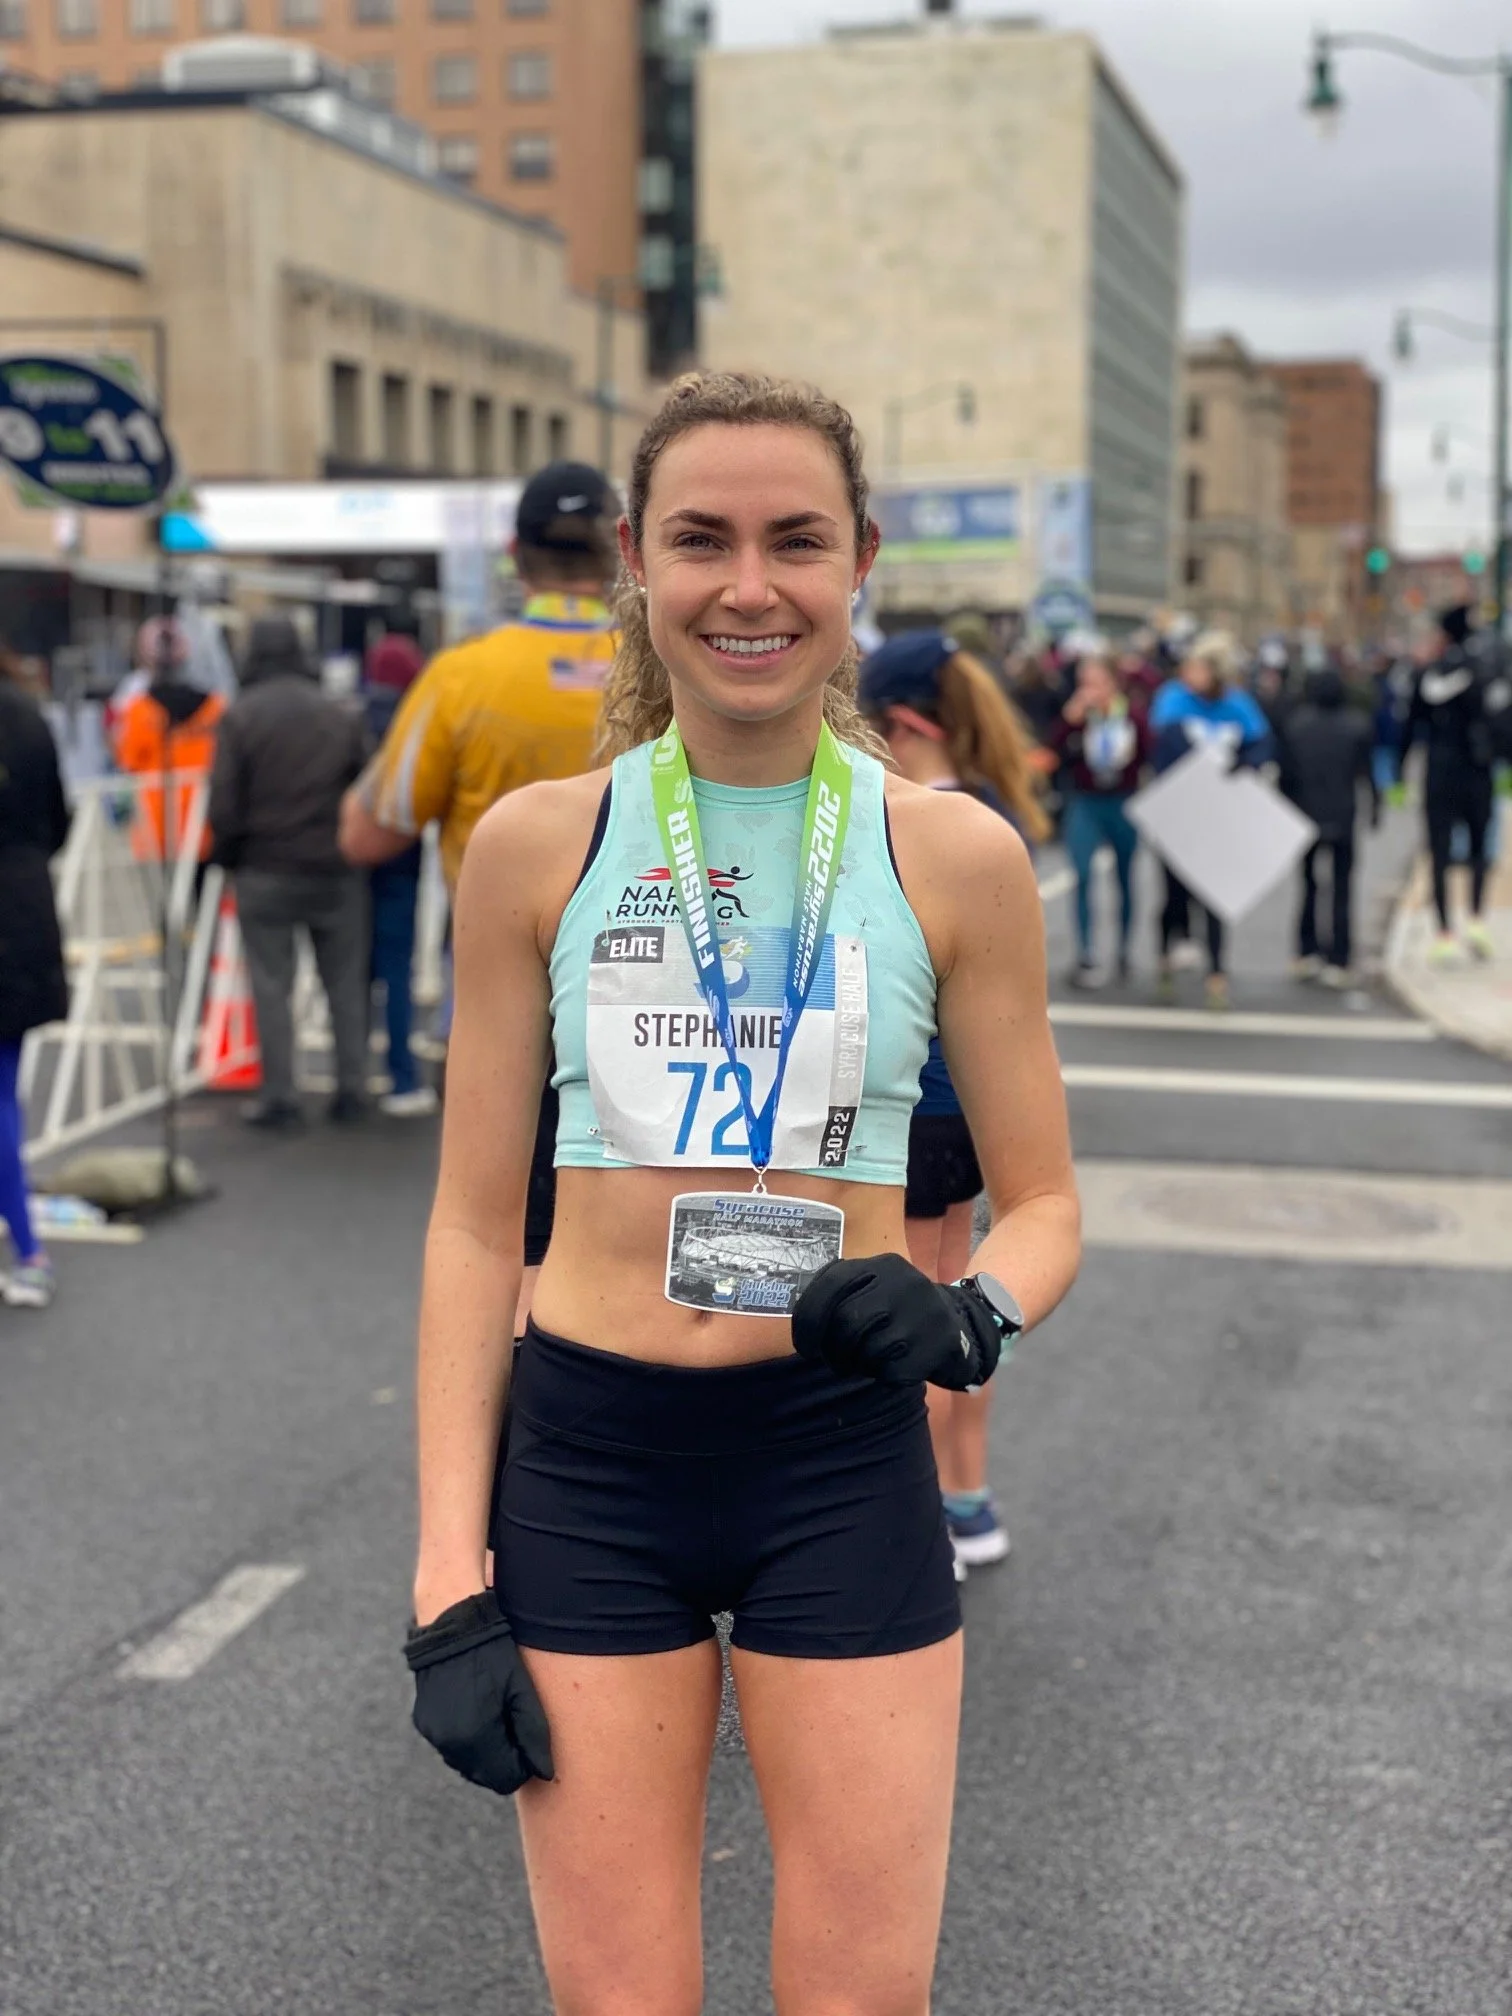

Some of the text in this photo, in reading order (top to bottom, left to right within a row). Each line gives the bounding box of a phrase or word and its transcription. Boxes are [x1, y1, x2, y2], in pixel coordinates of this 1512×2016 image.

[807, 780, 841, 889] 2022
[615, 904, 733, 919] RUNNG
[667, 806, 715, 970] FINISHER
[792, 878, 812, 989] HALF MARATHON
[609, 936, 658, 959] ELITE
[797, 880, 826, 998] Syracuse
[836, 967, 861, 1079] SYRACUSE HALF
[667, 1061, 752, 1156] 72
[824, 1111, 850, 1163] 2022
[714, 1199, 805, 1217] Syracuse
[737, 1290, 792, 1308] 2022
